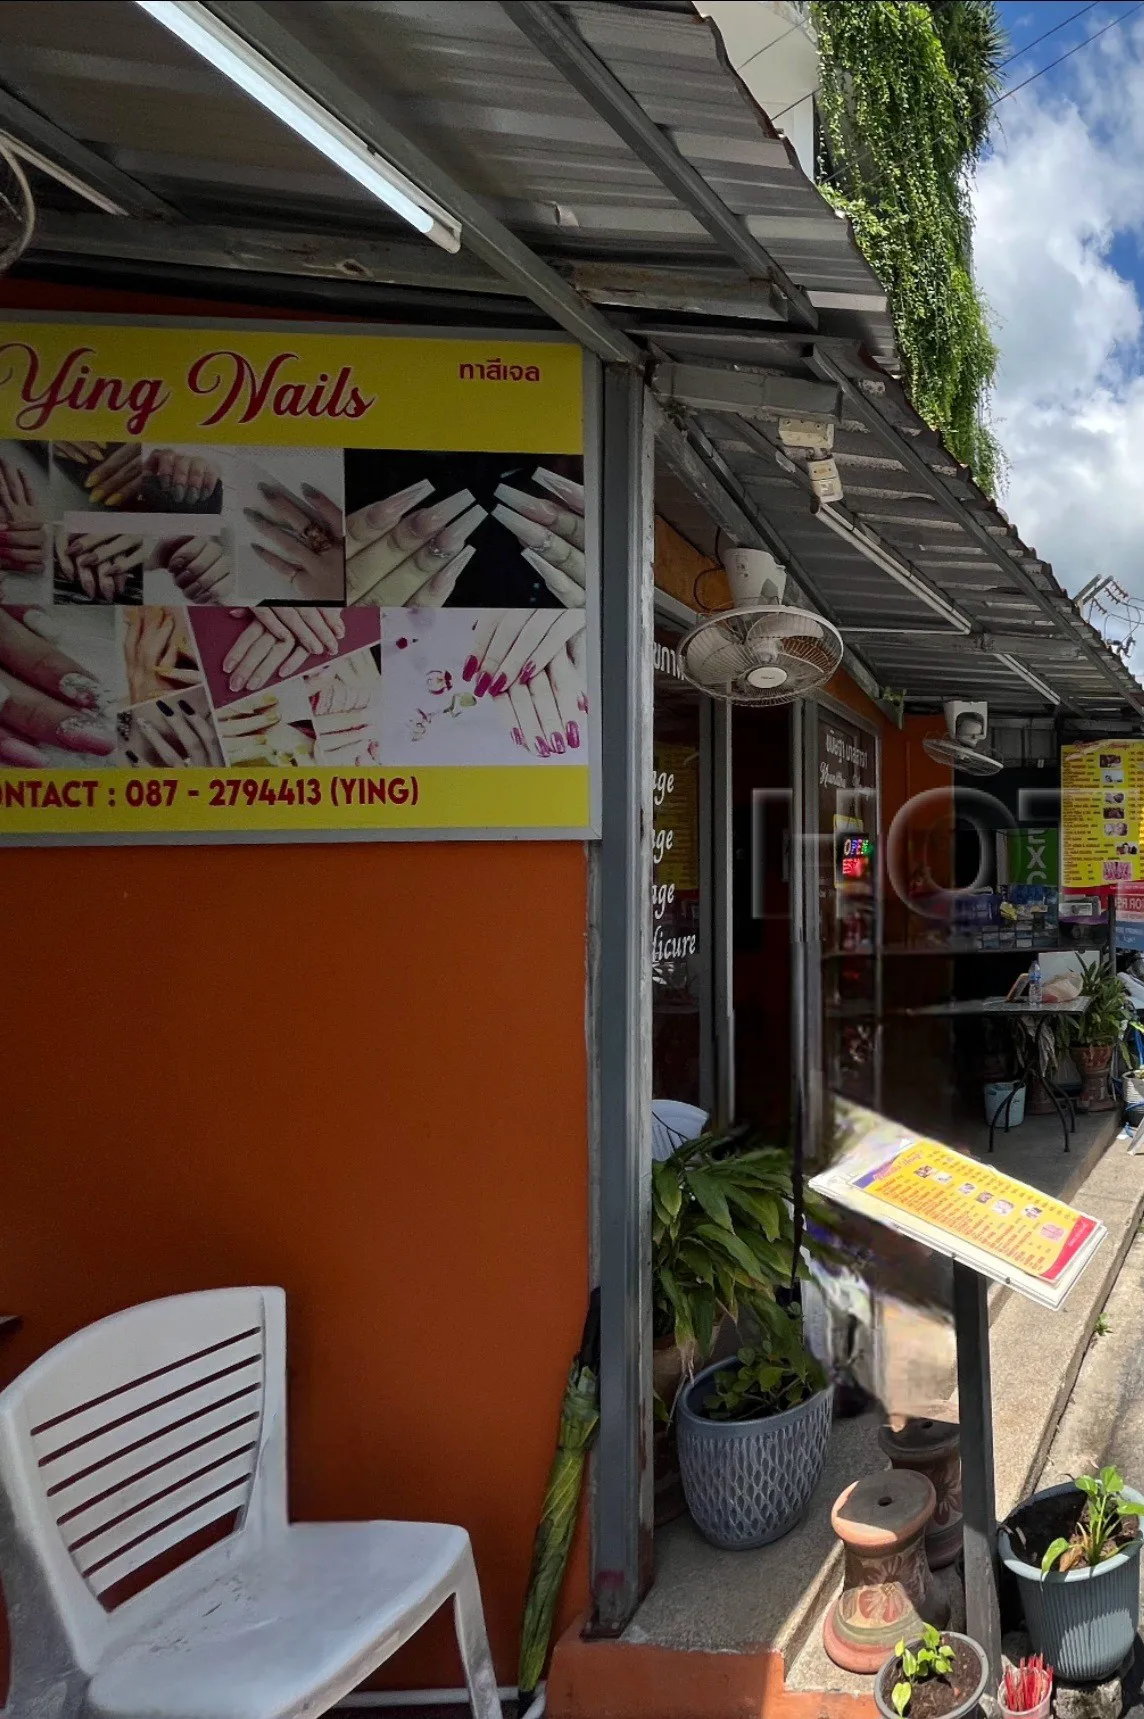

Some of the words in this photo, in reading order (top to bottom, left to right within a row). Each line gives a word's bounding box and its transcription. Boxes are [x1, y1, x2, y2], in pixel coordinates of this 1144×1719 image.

[0, 343, 171, 435] Ying
[187, 351, 375, 426] Nails
[0, 780, 98, 808] NTACT
[125, 779, 178, 808] 087
[208, 777, 322, 807] 2794413
[331, 776, 419, 806] (YING)
